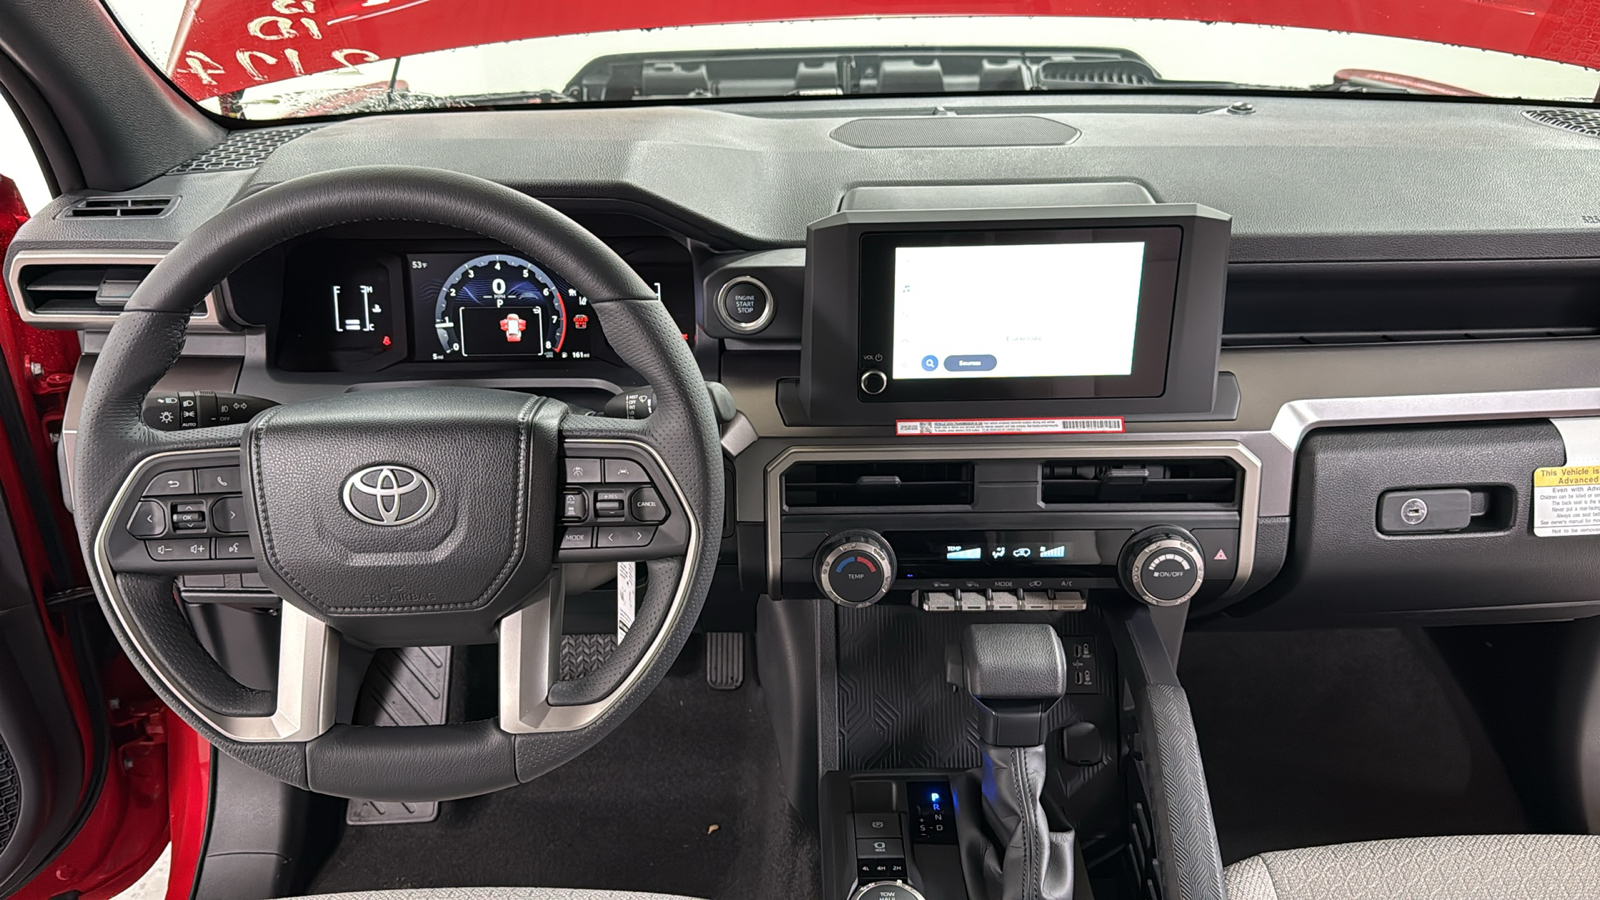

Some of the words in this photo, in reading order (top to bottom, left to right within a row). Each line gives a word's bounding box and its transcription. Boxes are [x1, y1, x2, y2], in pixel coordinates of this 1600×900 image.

[494, 262, 501, 271] 4
[468, 269, 475, 278] 3
[522, 269, 529, 278] 5
[491, 278, 506, 295] 0
[542, 288, 549, 296] 6
[497, 299, 504, 308] P
[551, 316, 558, 324] 7
[452, 343, 460, 351] 0
[545, 341, 552, 349] 8
[1541, 469, 1558, 477] This
[1561, 468, 1589, 476] Vehicle
[1592, 467, 1600, 475] is
[1558, 476, 1599, 485] Advanced
[931, 793, 939, 801] P
[933, 803, 941, 811] R
